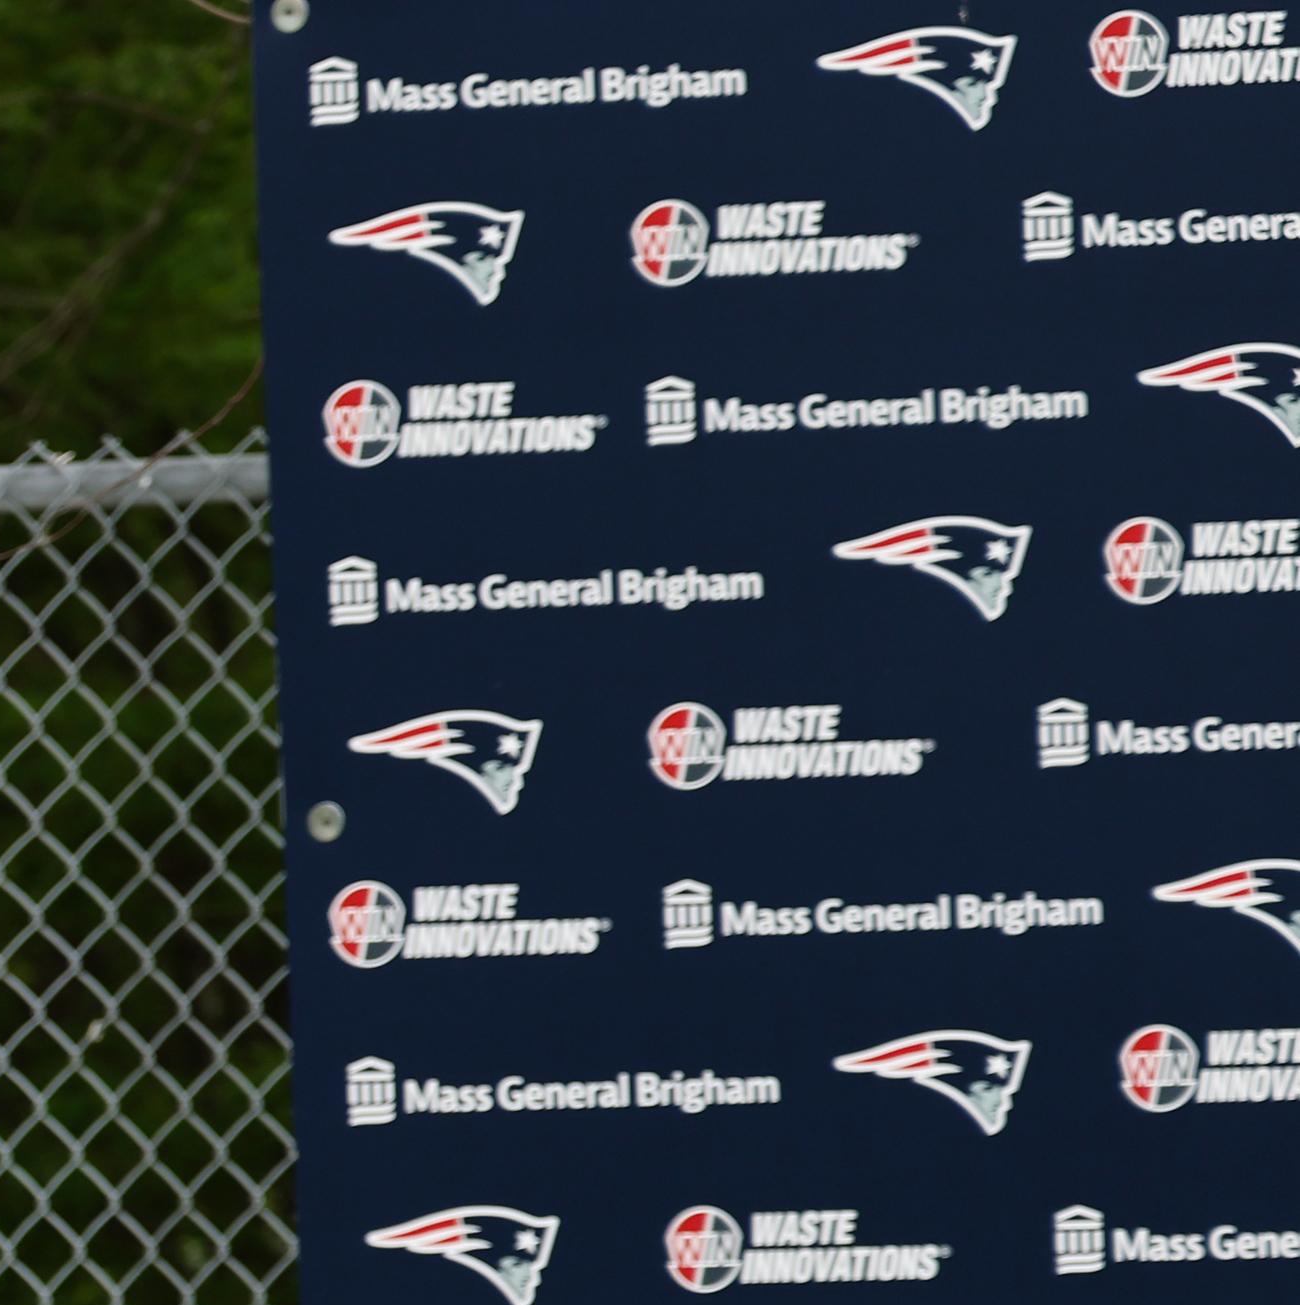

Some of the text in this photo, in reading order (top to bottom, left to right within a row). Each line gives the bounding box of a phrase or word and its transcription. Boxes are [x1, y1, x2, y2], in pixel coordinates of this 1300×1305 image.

[1178, 11, 1287, 49] WASTE
[367, 64, 746, 112] Mass General Brigham
[718, 201, 824, 239] WASTE
[1082, 213, 1174, 248] Mass
[409, 382, 515, 420] WASTE
[704, 386, 1087, 432] Mass General Brigham
[1192, 519, 1300, 557] WASTE
[386, 566, 763, 612] Mass General Brigham
[1180, 555, 1300, 594] INNOVA
[734, 705, 841, 743] WASTE
[1097, 717, 1300, 755] Mass Gener
[414, 884, 519, 921] WASTE
[721, 892, 1103, 936] Mass General Brigham
[404, 1070, 780, 1113] Mass General Brigham
[751, 1210, 857, 1247] WASTE
[1113, 1228, 1205, 1262] Mass
